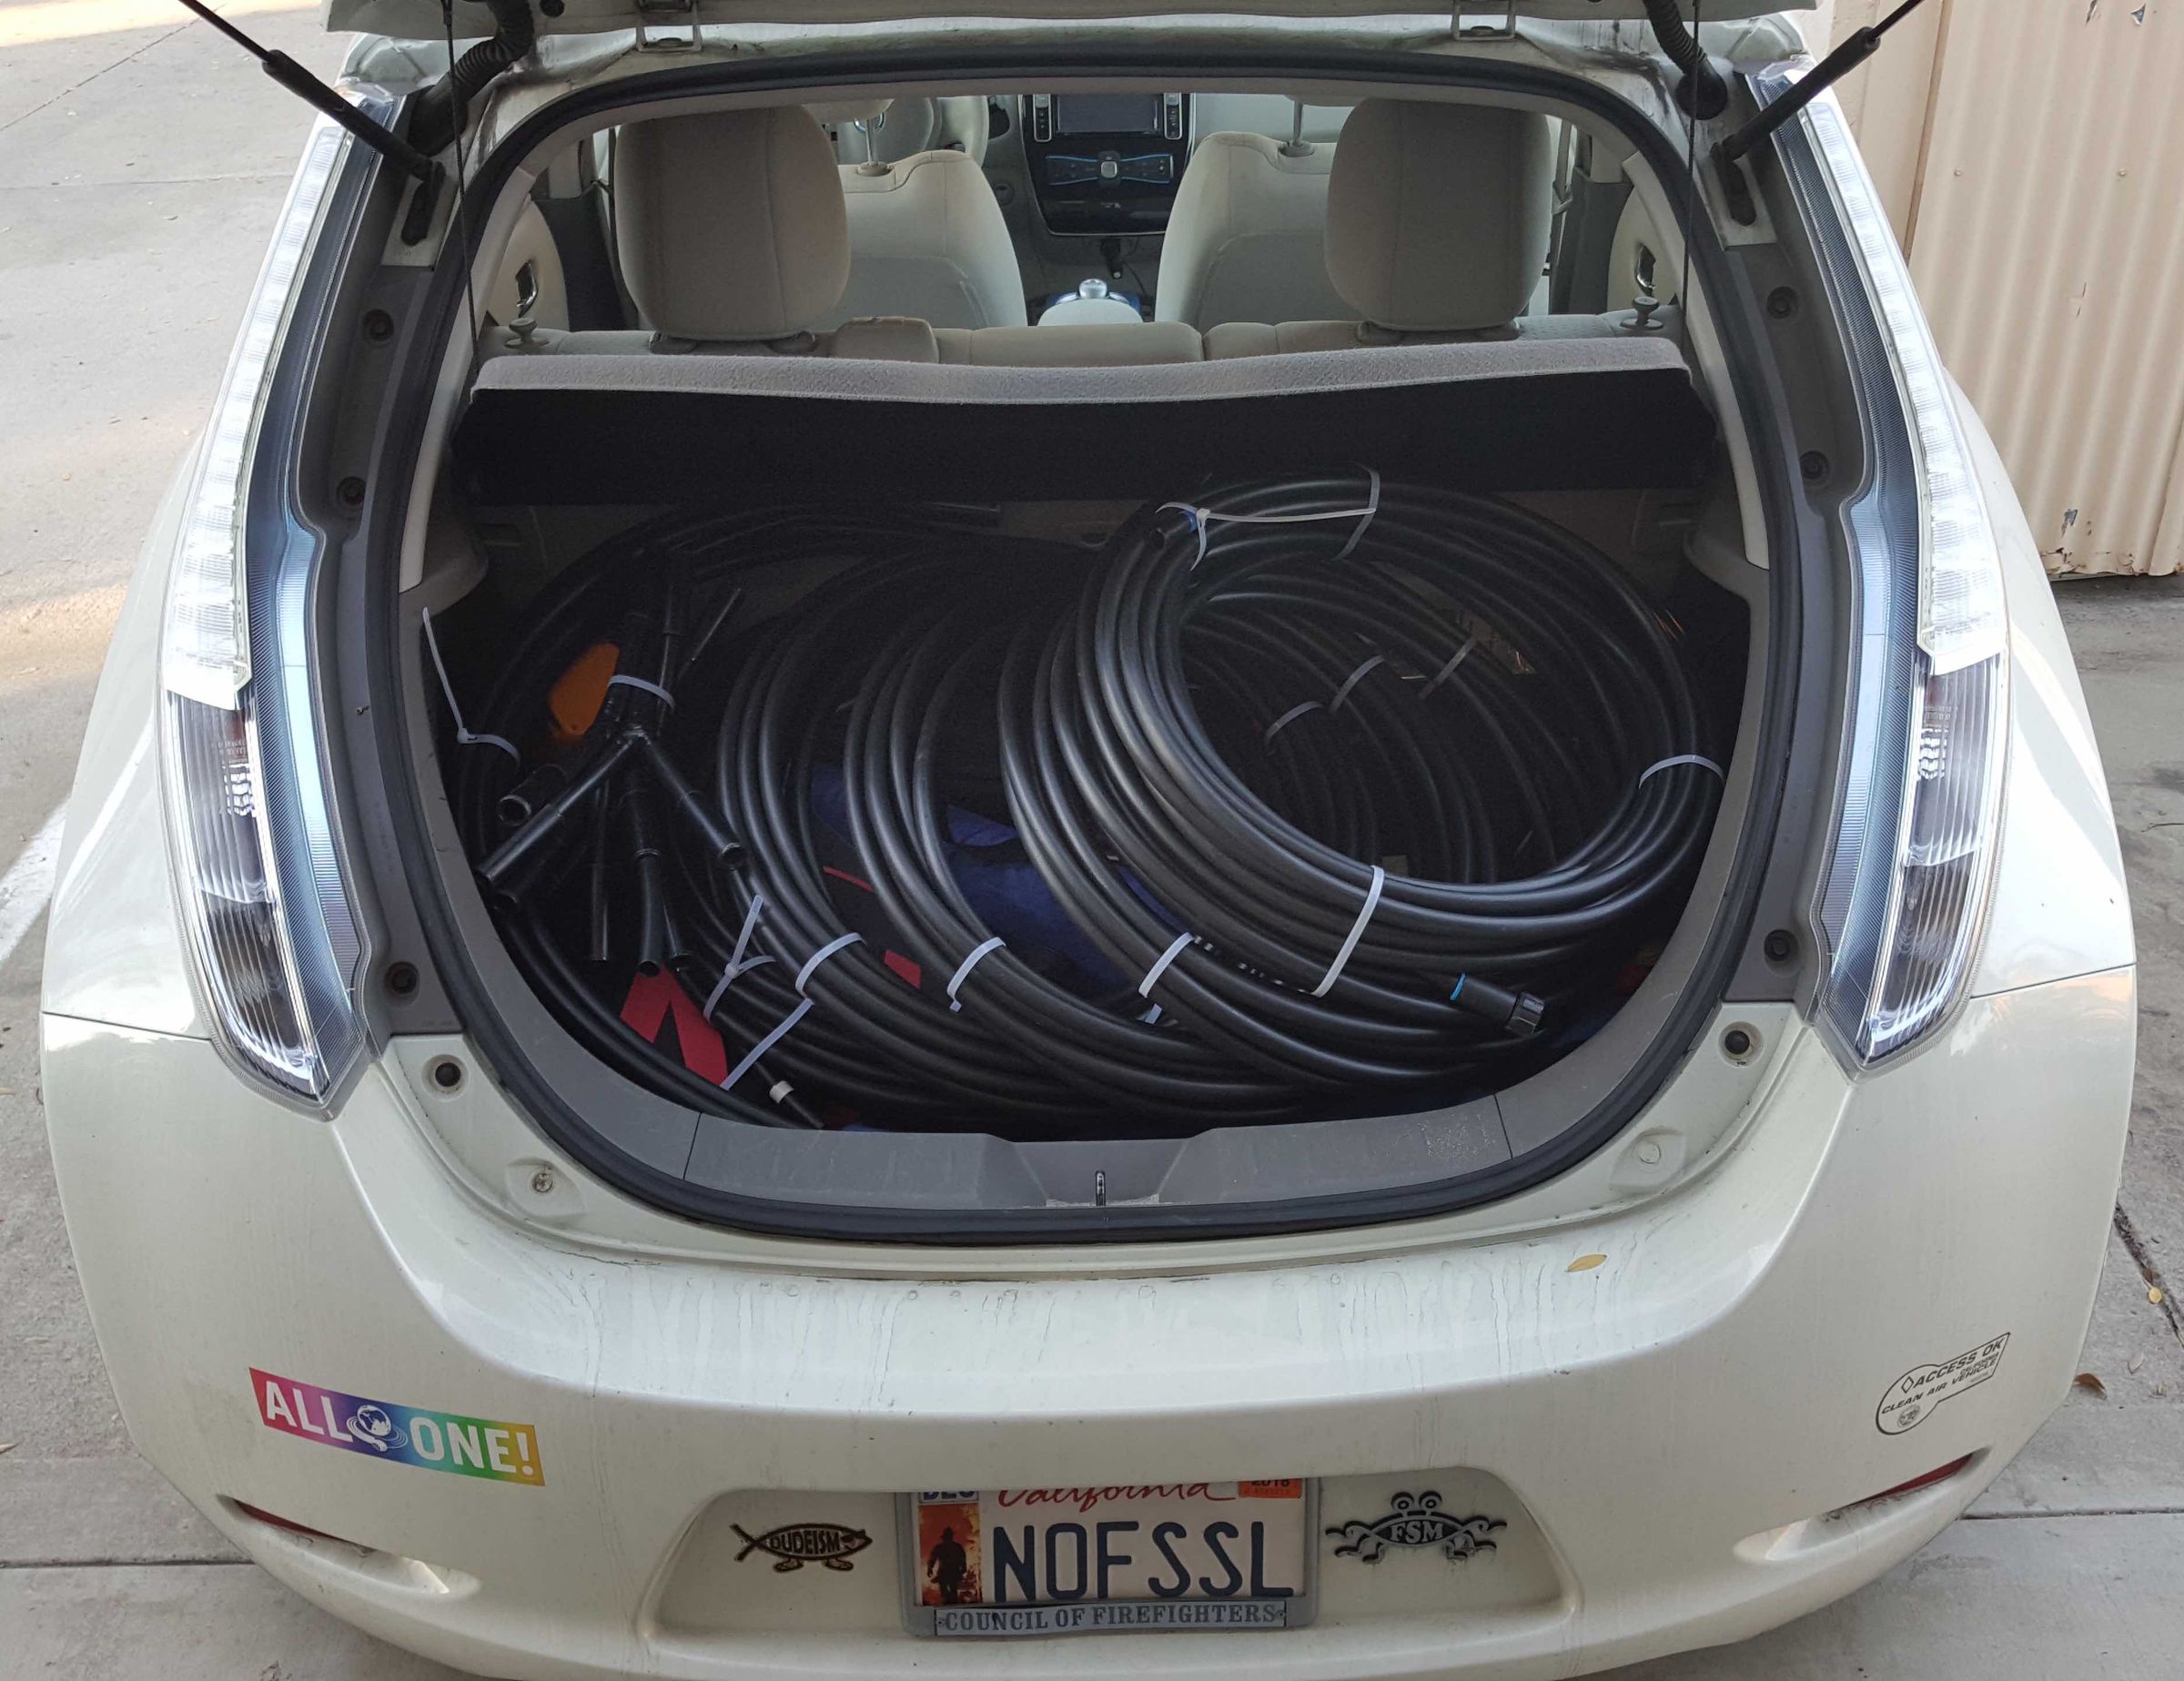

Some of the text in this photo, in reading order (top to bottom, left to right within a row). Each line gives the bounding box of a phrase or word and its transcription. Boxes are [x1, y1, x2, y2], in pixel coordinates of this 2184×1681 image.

[1913, 1352, 1977, 1388] ACCESS
[1982, 1337, 2006, 1356] OK
[1882, 1392, 1924, 1413] CLEAN
[1926, 1382, 1947, 1395] AIR
[265, 1380, 534, 1476] ALL ONE!
[769, 1530, 841, 1554] DUDEISM
[1390, 1521, 1444, 1544] FSM
[993, 1521, 1294, 1603] NOFSSL
[945, 1603, 1275, 1631] COUNCIL OF FIREFIGHTERS
